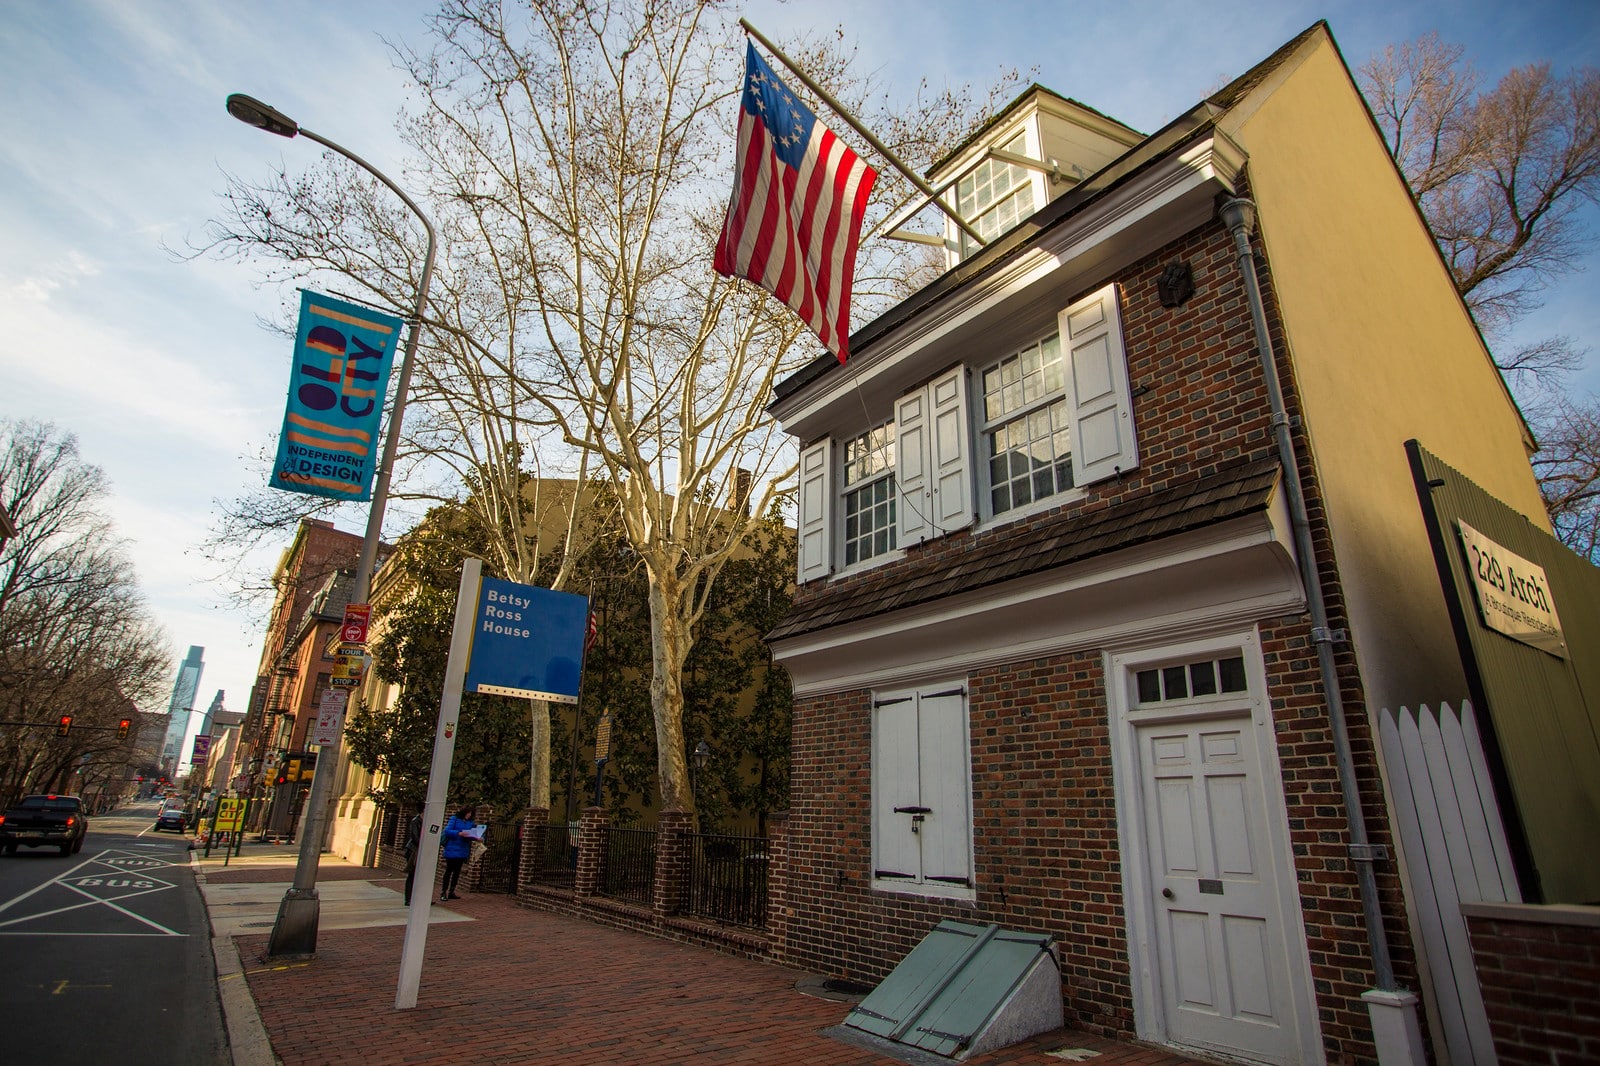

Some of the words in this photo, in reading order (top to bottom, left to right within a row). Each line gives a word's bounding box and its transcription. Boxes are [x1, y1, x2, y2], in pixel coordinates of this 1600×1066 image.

[298, 326, 347, 411] OLD
[288, 445, 365, 467] INDEPENDENT
[299, 460, 363, 483] DESIGN
[1472, 544, 1505, 592] 229
[1507, 566, 1551, 614] Arch
[487, 589, 531, 609] Betsy
[485, 605, 522, 621] Ross
[483, 620, 530, 638] House
[340, 648, 361, 656] TOUR
[221, 801, 245, 811] OLD
[106, 859, 162, 867] BUS
[76, 878, 155, 889] BUS
